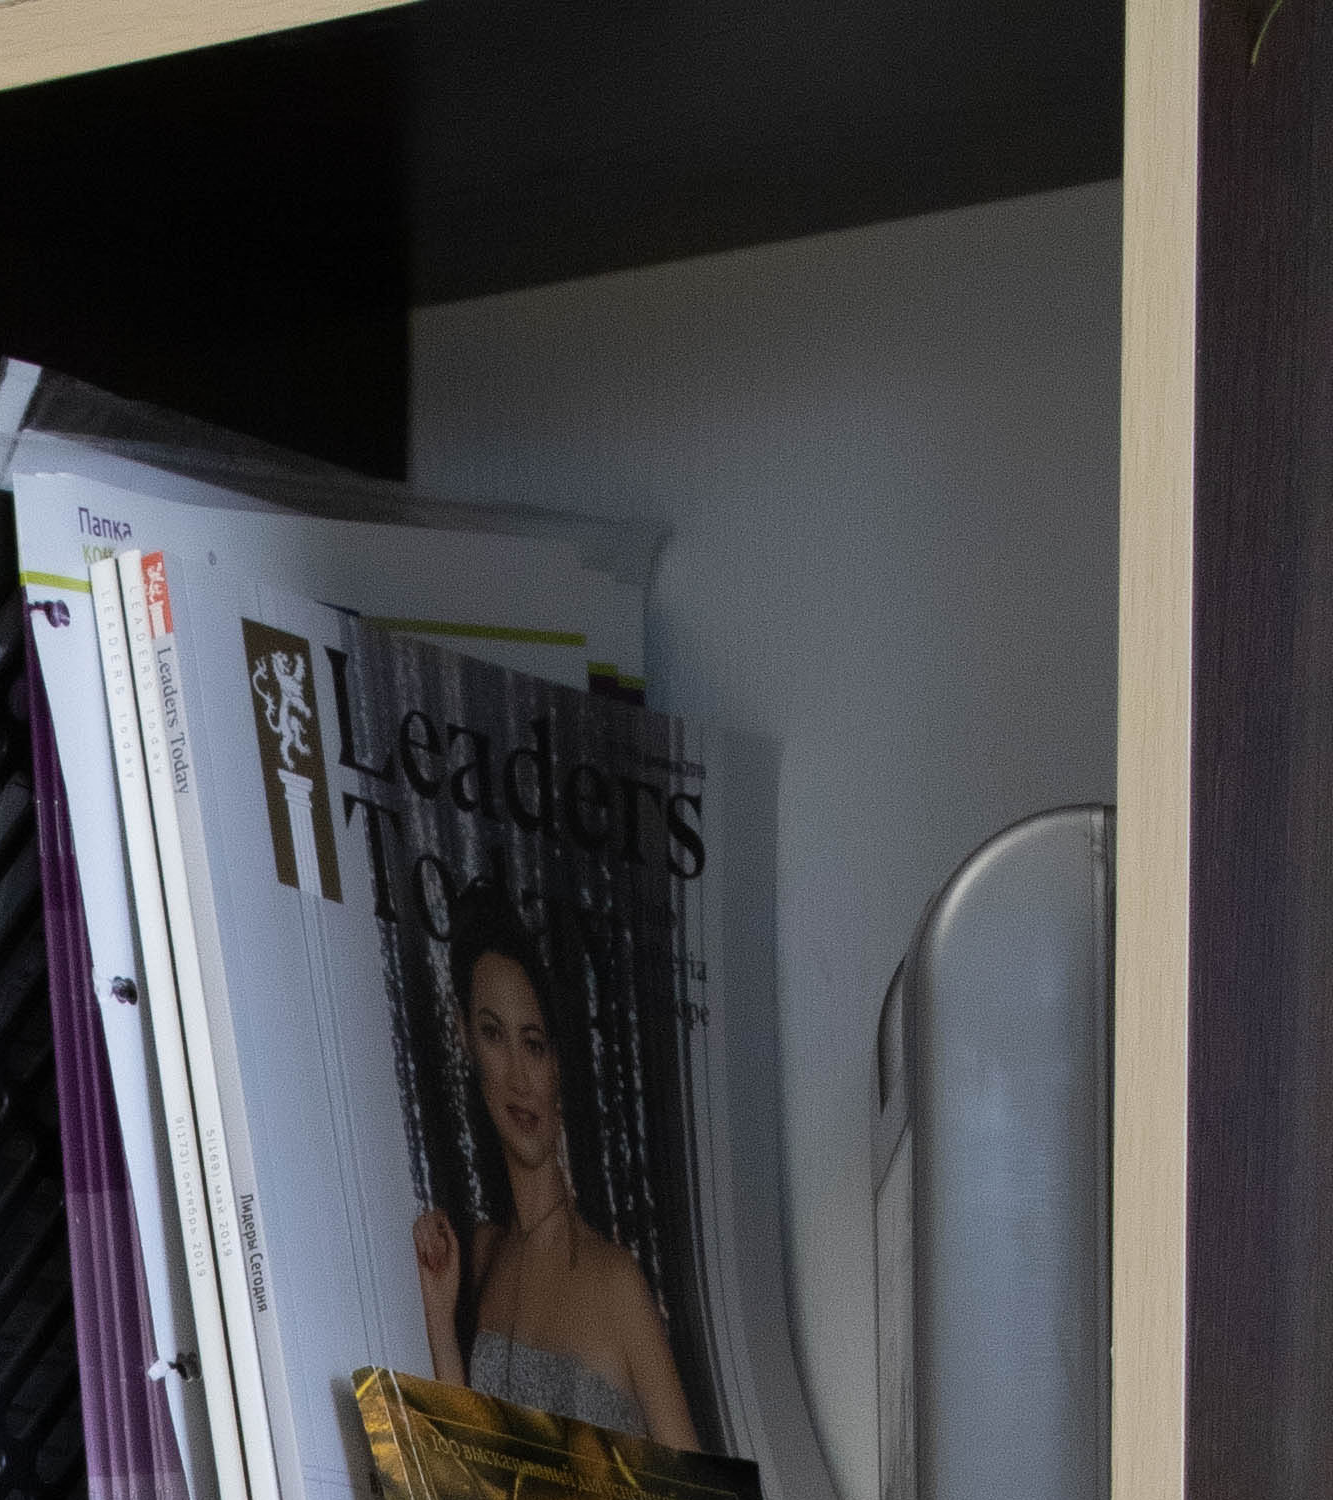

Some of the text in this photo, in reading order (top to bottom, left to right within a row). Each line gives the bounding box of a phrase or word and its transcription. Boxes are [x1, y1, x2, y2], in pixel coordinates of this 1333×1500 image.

[78, 506, 132, 541] Папка
[156, 647, 191, 796] Leaders Today
[325, 646, 705, 880] Leaders
[240, 1194, 269, 1313] Лидеры Сегодня
